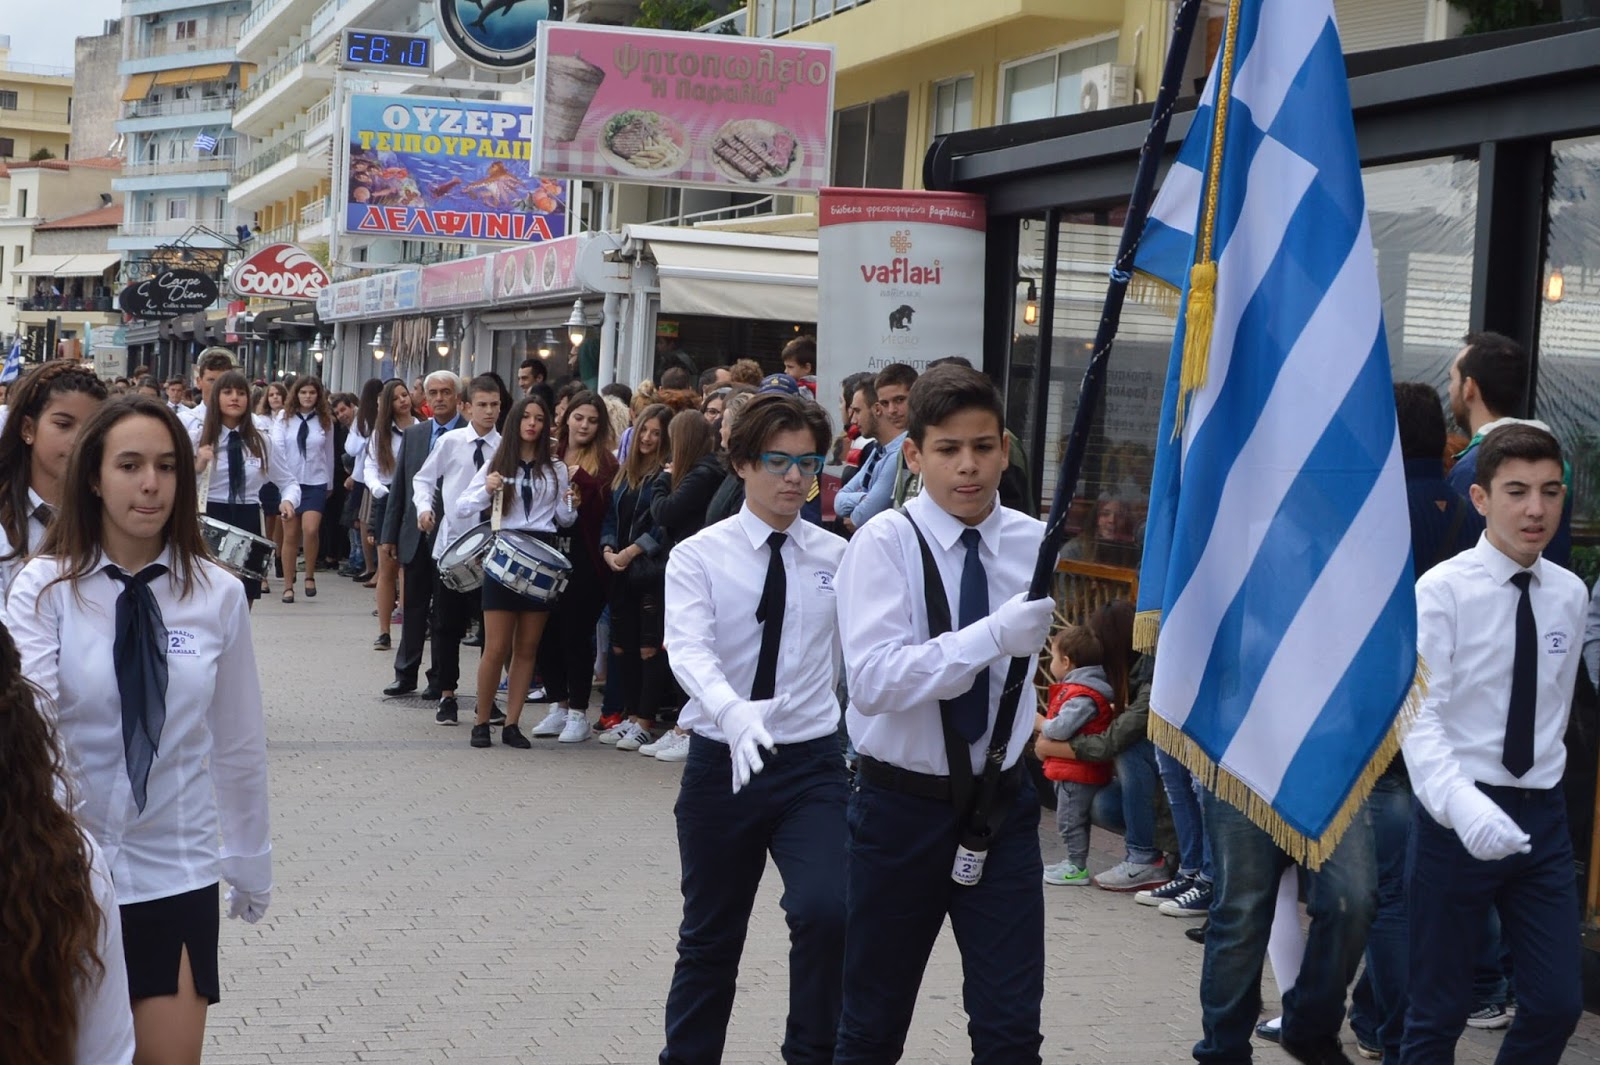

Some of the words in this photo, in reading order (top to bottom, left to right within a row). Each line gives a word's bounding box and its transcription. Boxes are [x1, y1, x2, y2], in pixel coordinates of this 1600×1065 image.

[357, 205, 554, 241] ΔΕΛΦΙΝΙΑ
[159, 272, 200, 290] Carpe
[167, 284, 207, 302] Diem
